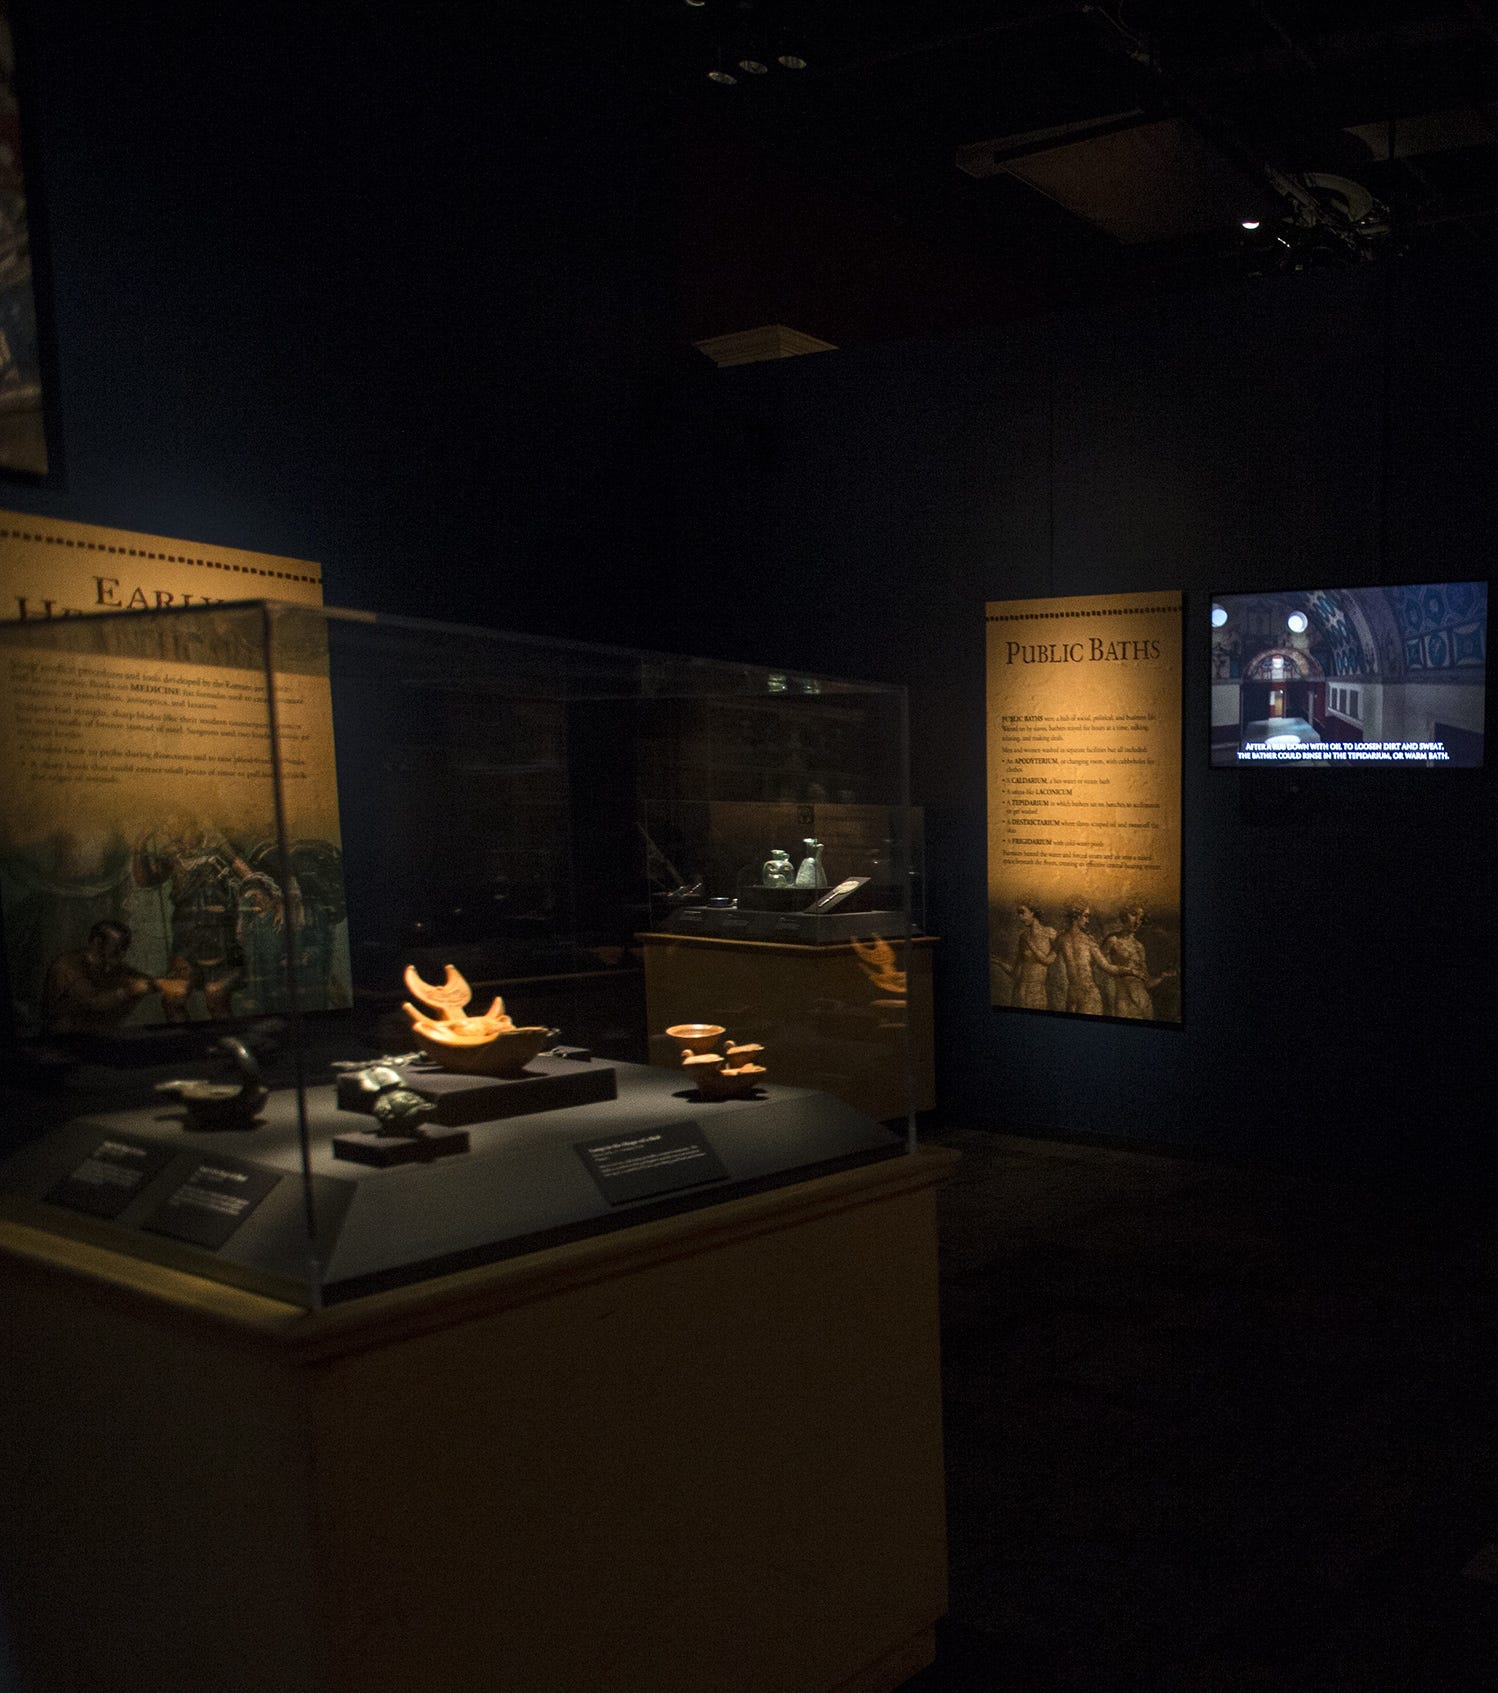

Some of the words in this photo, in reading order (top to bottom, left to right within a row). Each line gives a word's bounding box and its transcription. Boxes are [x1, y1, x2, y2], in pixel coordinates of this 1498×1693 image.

[1005, 640, 1085, 665] PUBLIC
[1088, 637, 1161, 662] BATHS
[130, 682, 179, 696] MEDICINE
[1287, 742, 1309, 751] DOWN
[1309, 742, 1329, 751] WITH
[1330, 742, 1342, 751] OIL
[1343, 742, 1354, 751] TO
[1354, 742, 1382, 751] LOOSEN
[1383, 742, 1401, 751] DIRT
[1401, 742, 1419, 751] AND
[1237, 751, 1251, 760] THE
[1251, 751, 1277, 760] BATHER
[1277, 751, 1302, 760] COULD
[1302, 751, 1322, 760] RINSE
[1323, 751, 1332, 760] IN
[1332, 751, 1348, 760] THE
[1348, 751, 1392, 760] TEPIDARIUM,
[1392, 751, 1404, 760] OR
[1404, 751, 1428, 760] WARM
[1428, 751, 1450, 760] BATH.
